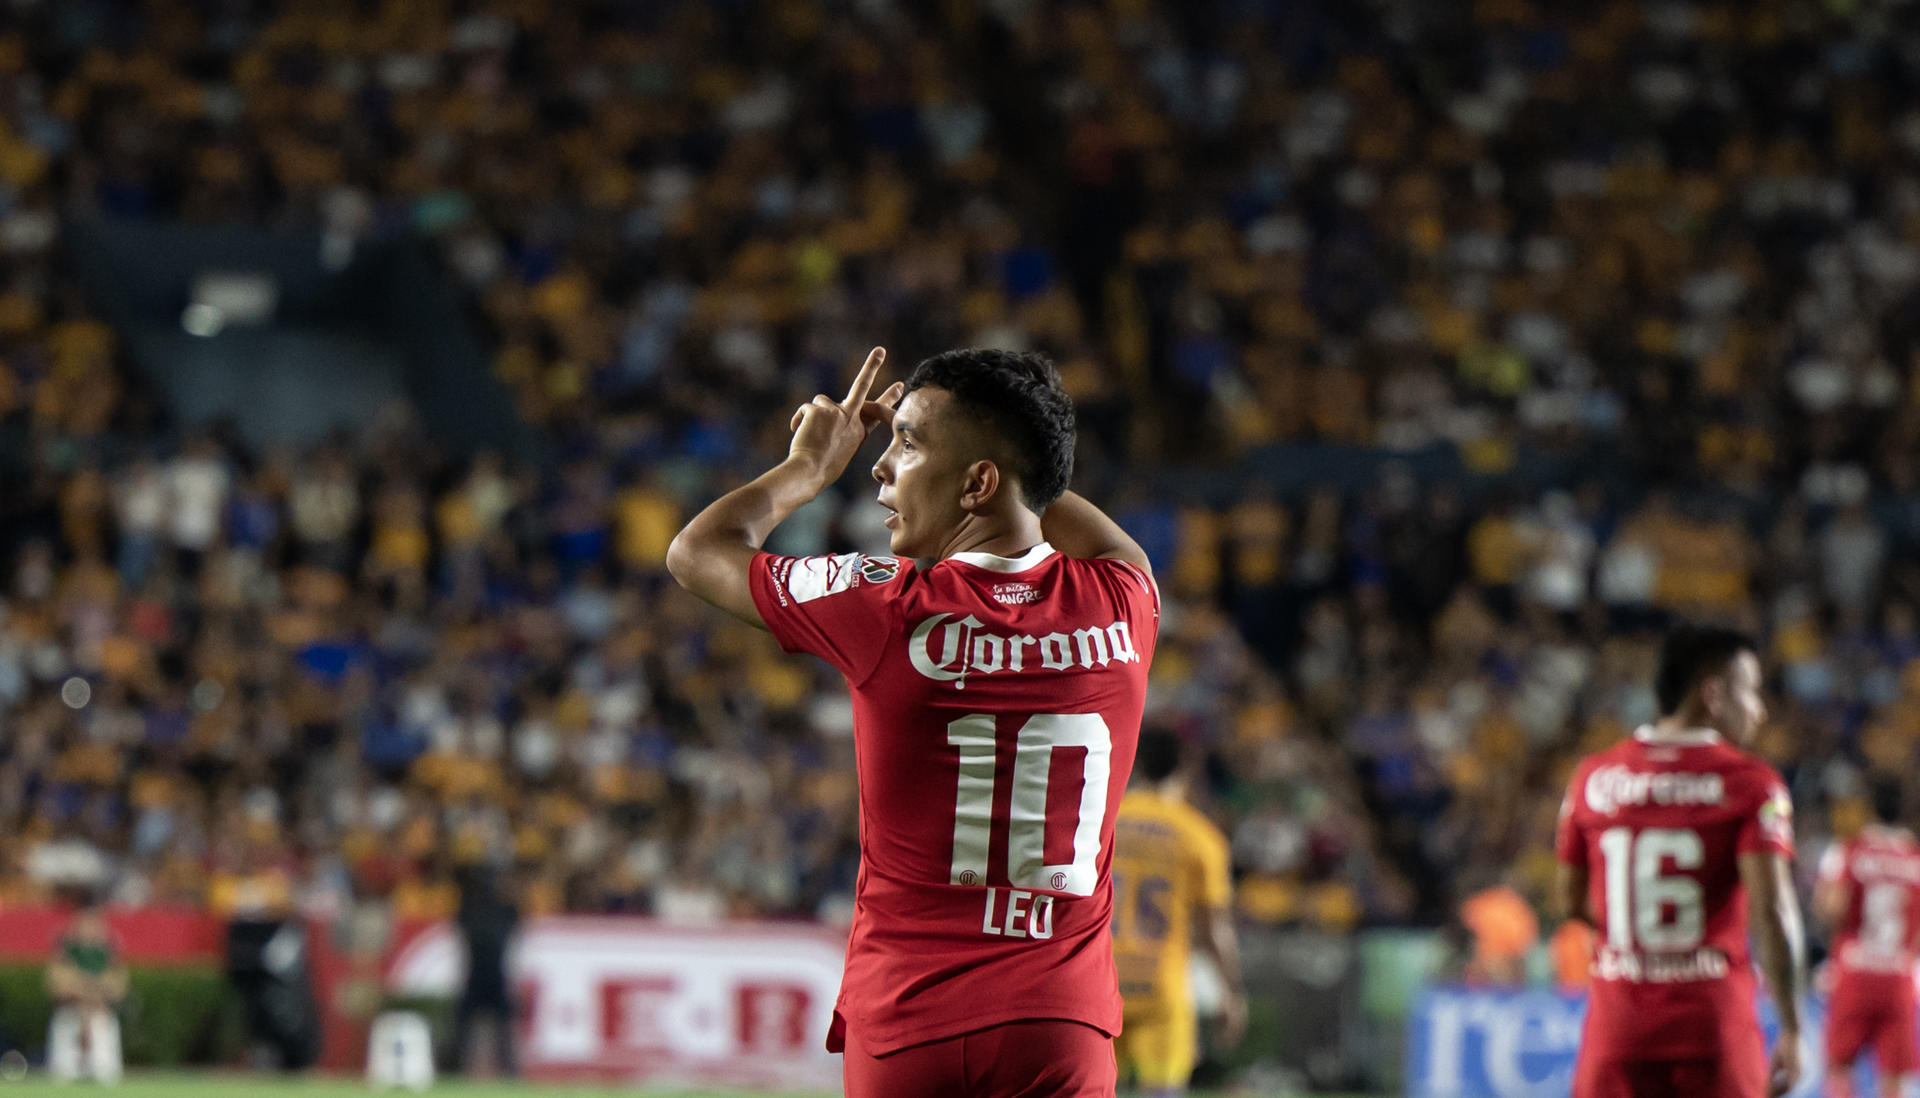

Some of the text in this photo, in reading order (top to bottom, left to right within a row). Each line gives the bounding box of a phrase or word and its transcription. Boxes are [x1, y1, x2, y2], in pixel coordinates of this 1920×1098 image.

[947, 713, 1112, 897] 10
[983, 888, 1054, 939] LEO
[1600, 826, 1705, 952] 16
